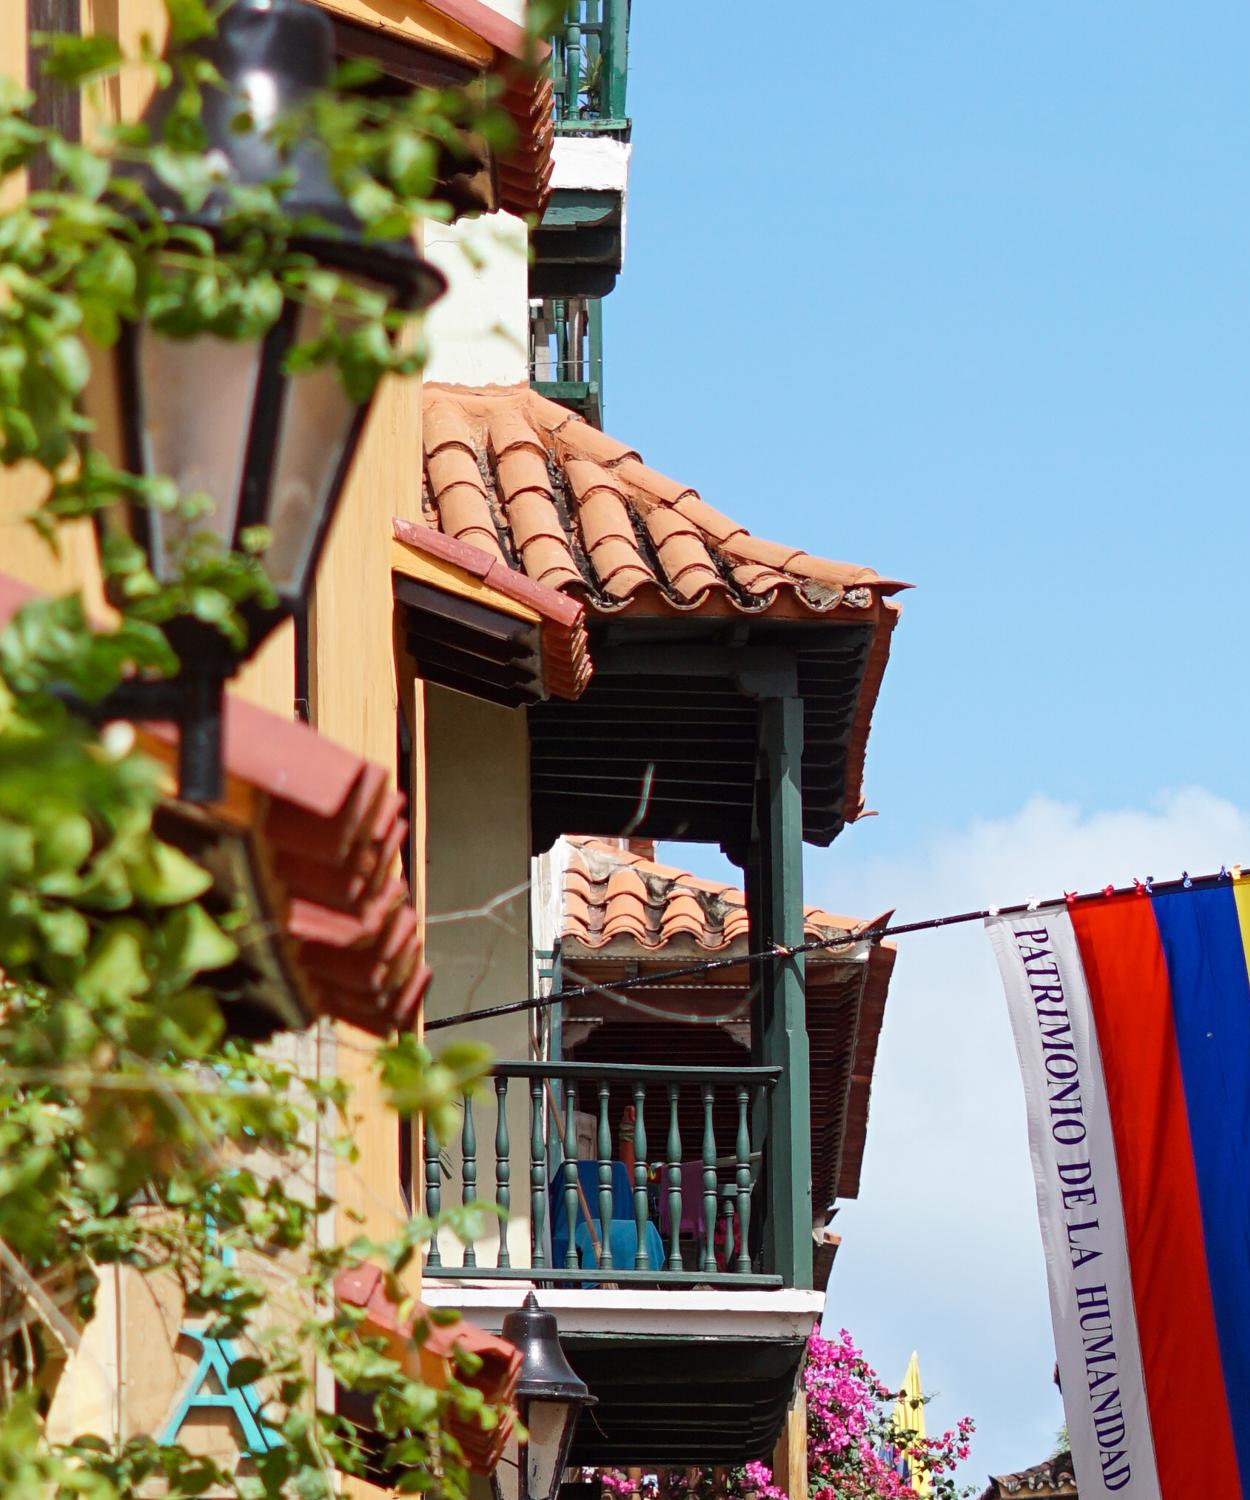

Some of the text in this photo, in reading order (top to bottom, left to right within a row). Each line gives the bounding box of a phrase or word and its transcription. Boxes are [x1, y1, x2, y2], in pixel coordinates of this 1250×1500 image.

[1014, 926, 1132, 1492] PATRIMONIO DE LA HUMANIDAD
